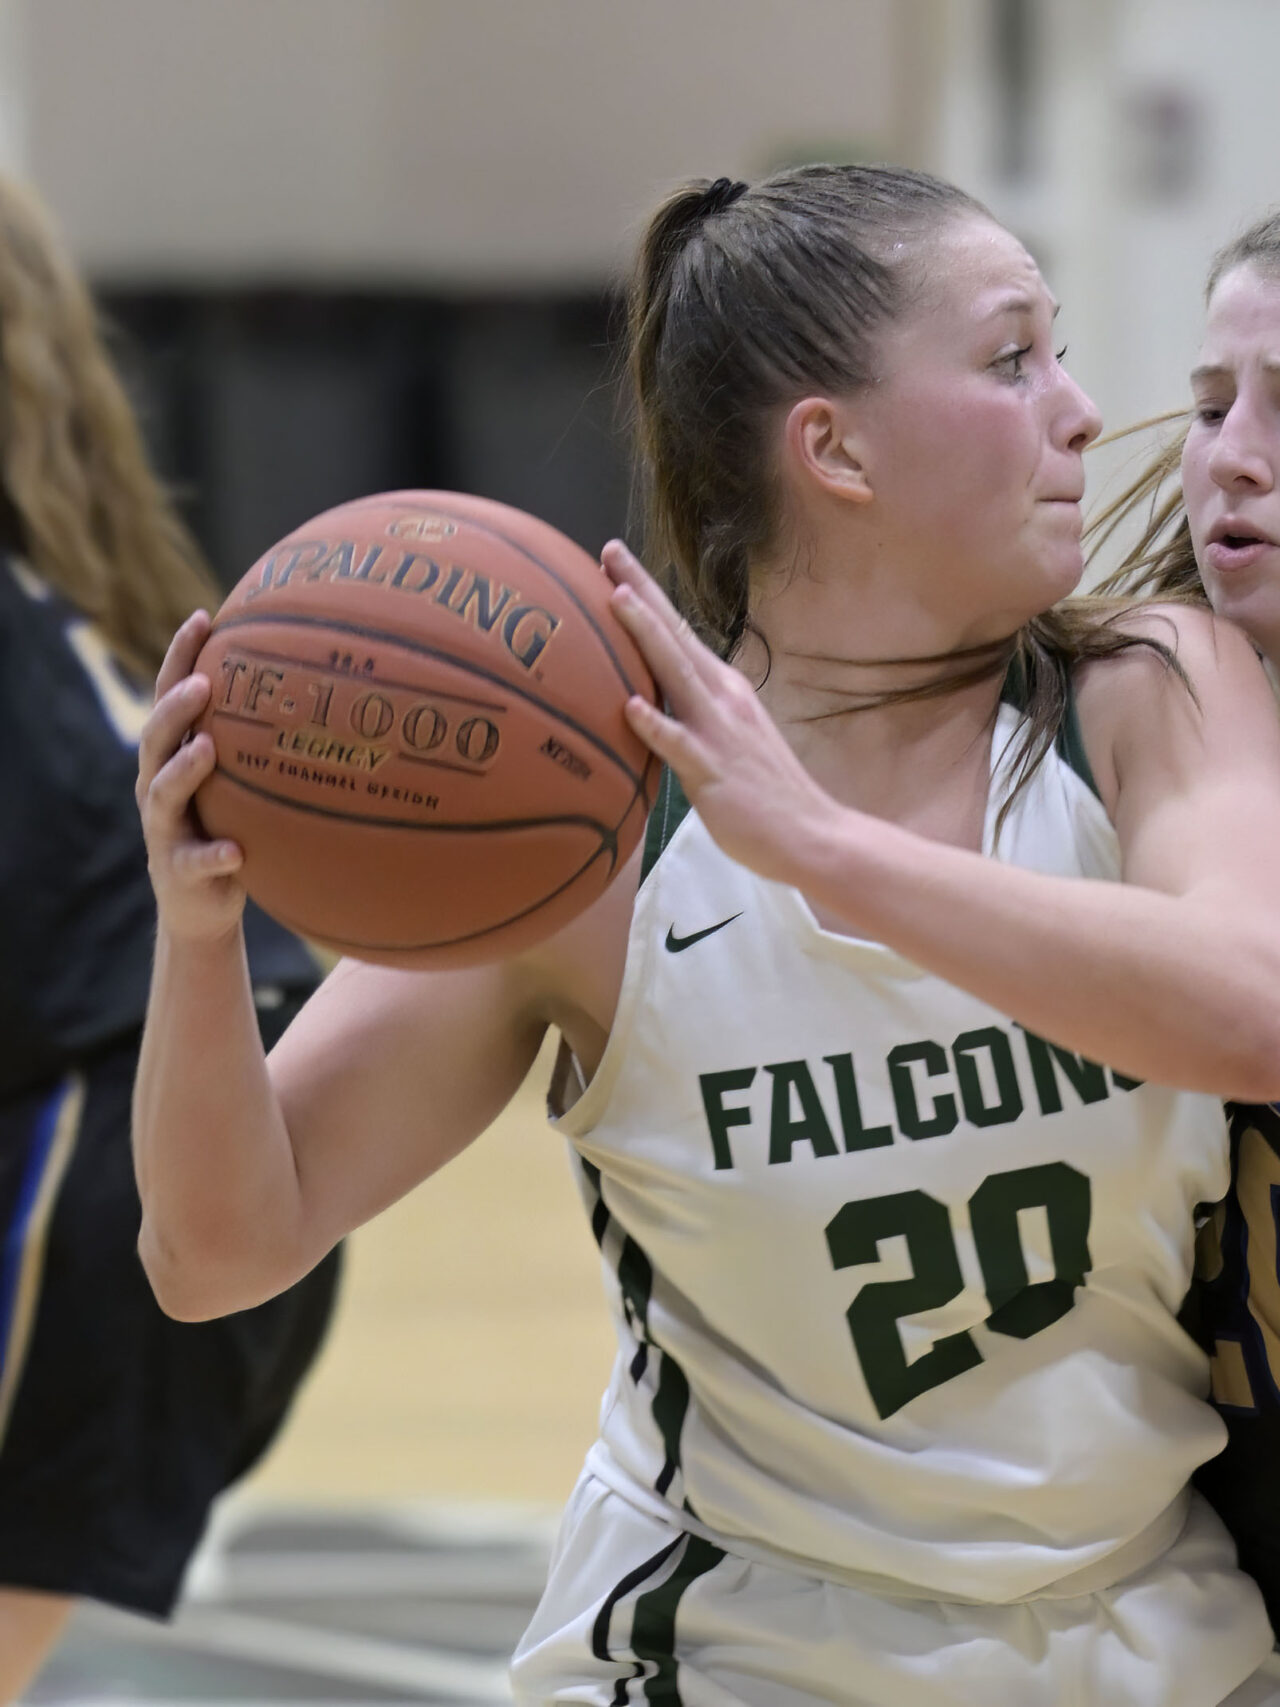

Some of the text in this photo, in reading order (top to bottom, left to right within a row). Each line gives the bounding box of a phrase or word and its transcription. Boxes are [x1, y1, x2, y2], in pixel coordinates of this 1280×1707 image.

[244, 540, 561, 671] SPALDING
[699, 1021, 1147, 1170] FALCON
[825, 1161, 1092, 1420] 20
